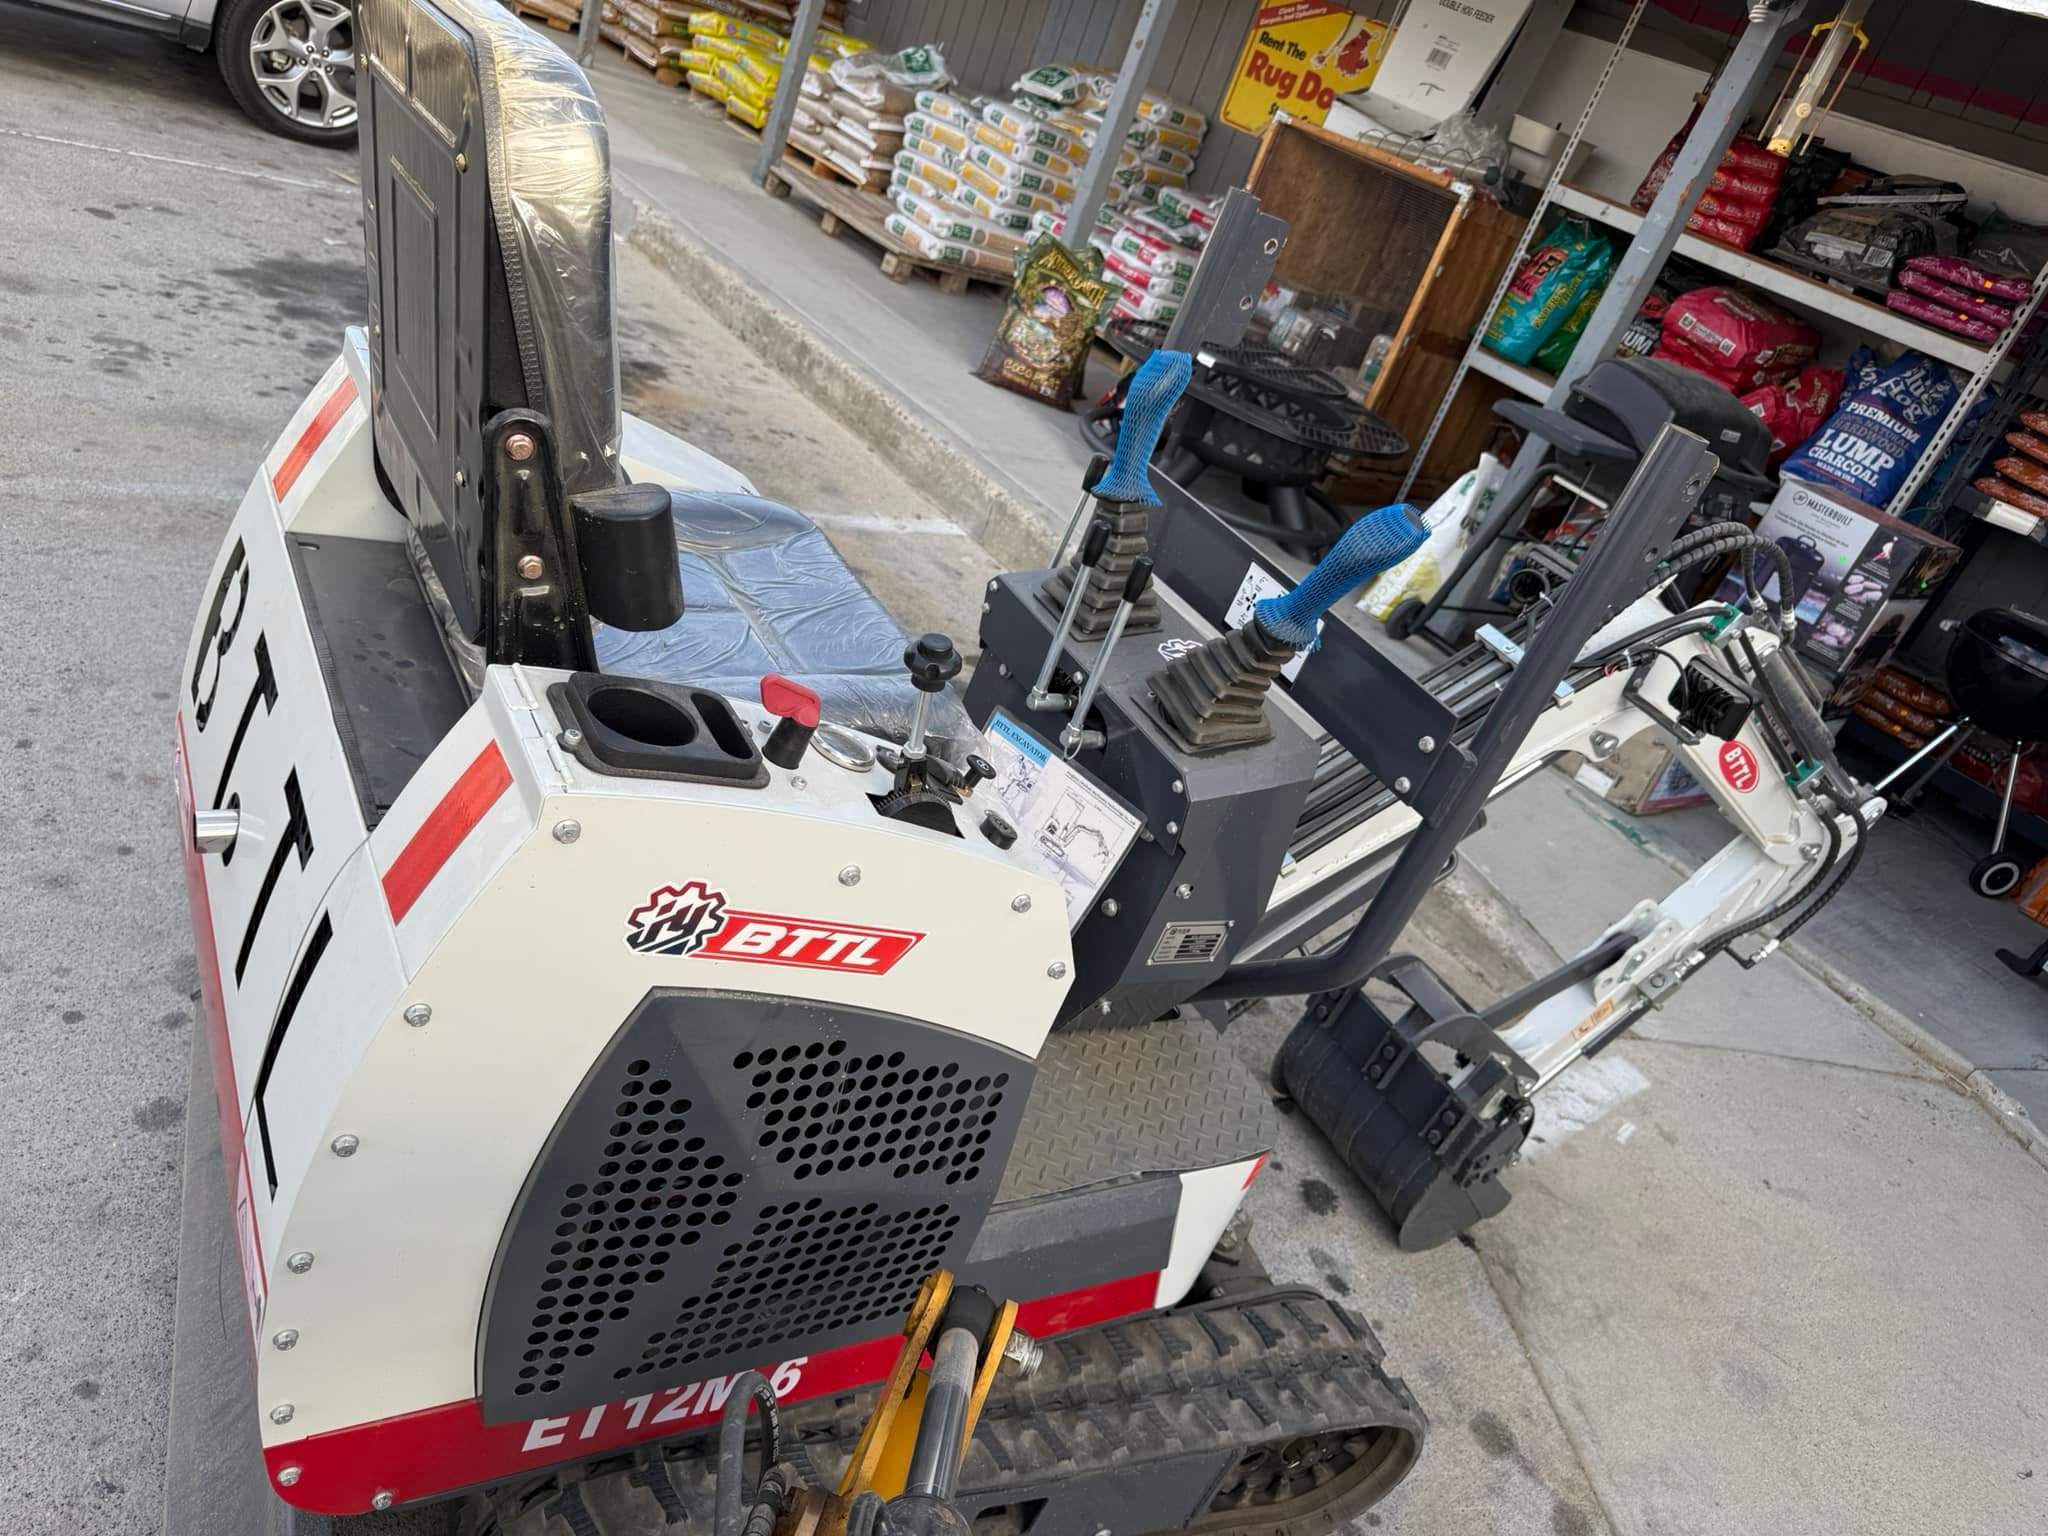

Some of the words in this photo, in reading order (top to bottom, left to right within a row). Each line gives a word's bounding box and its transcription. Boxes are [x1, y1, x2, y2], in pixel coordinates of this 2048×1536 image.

[1259, 31, 1286, 51] Rent
[1286, 40, 1306, 61] The
[1246, 49, 1298, 99] Rug
[1831, 418, 1906, 459] HARDWOOD
[1845, 401, 1921, 444] PREMIUM
[1808, 446, 1880, 488] CHARCOAL
[1816, 428, 1896, 473] LUMP
[1806, 498, 1854, 527] MASTERBUILT
[1011, 731, 1048, 762] EXCAVATOR
[1724, 746, 1753, 789] BTTL
[720, 922, 883, 966] BTTL
